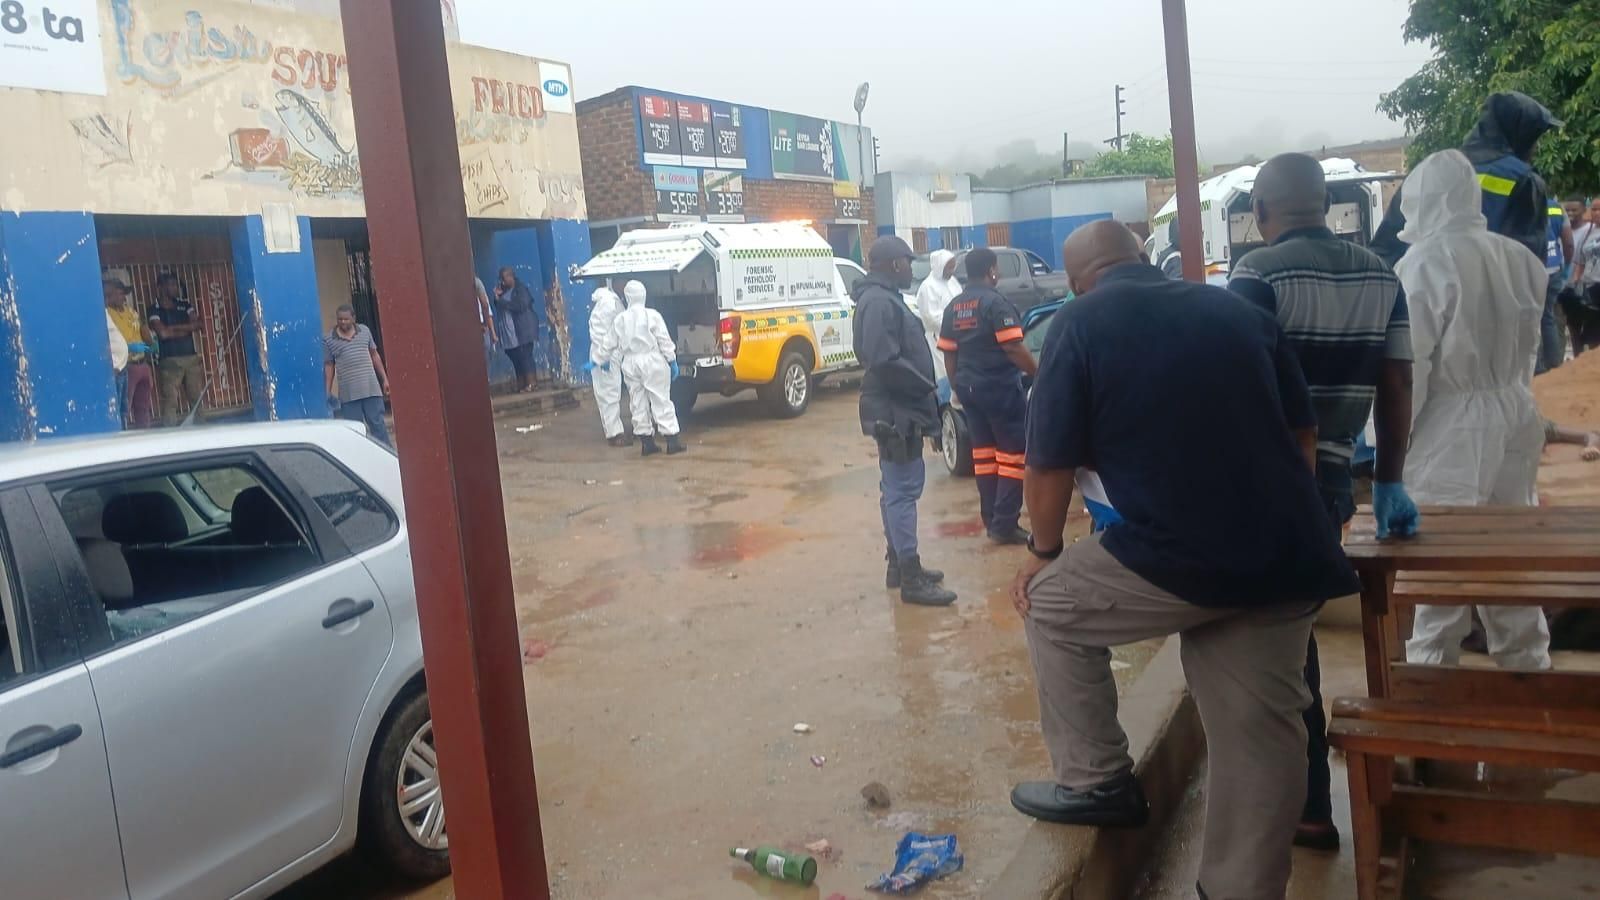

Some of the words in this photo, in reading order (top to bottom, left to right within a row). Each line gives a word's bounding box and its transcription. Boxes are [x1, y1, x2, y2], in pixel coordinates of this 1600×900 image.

[548, 82, 564, 94] MTN
[471, 76, 544, 119] FRIED
[773, 135, 792, 152] LITE
[746, 265, 773, 275] FORENSIC
[743, 274, 777, 285] PATHOLOGY
[747, 283, 774, 294] SERVICES
